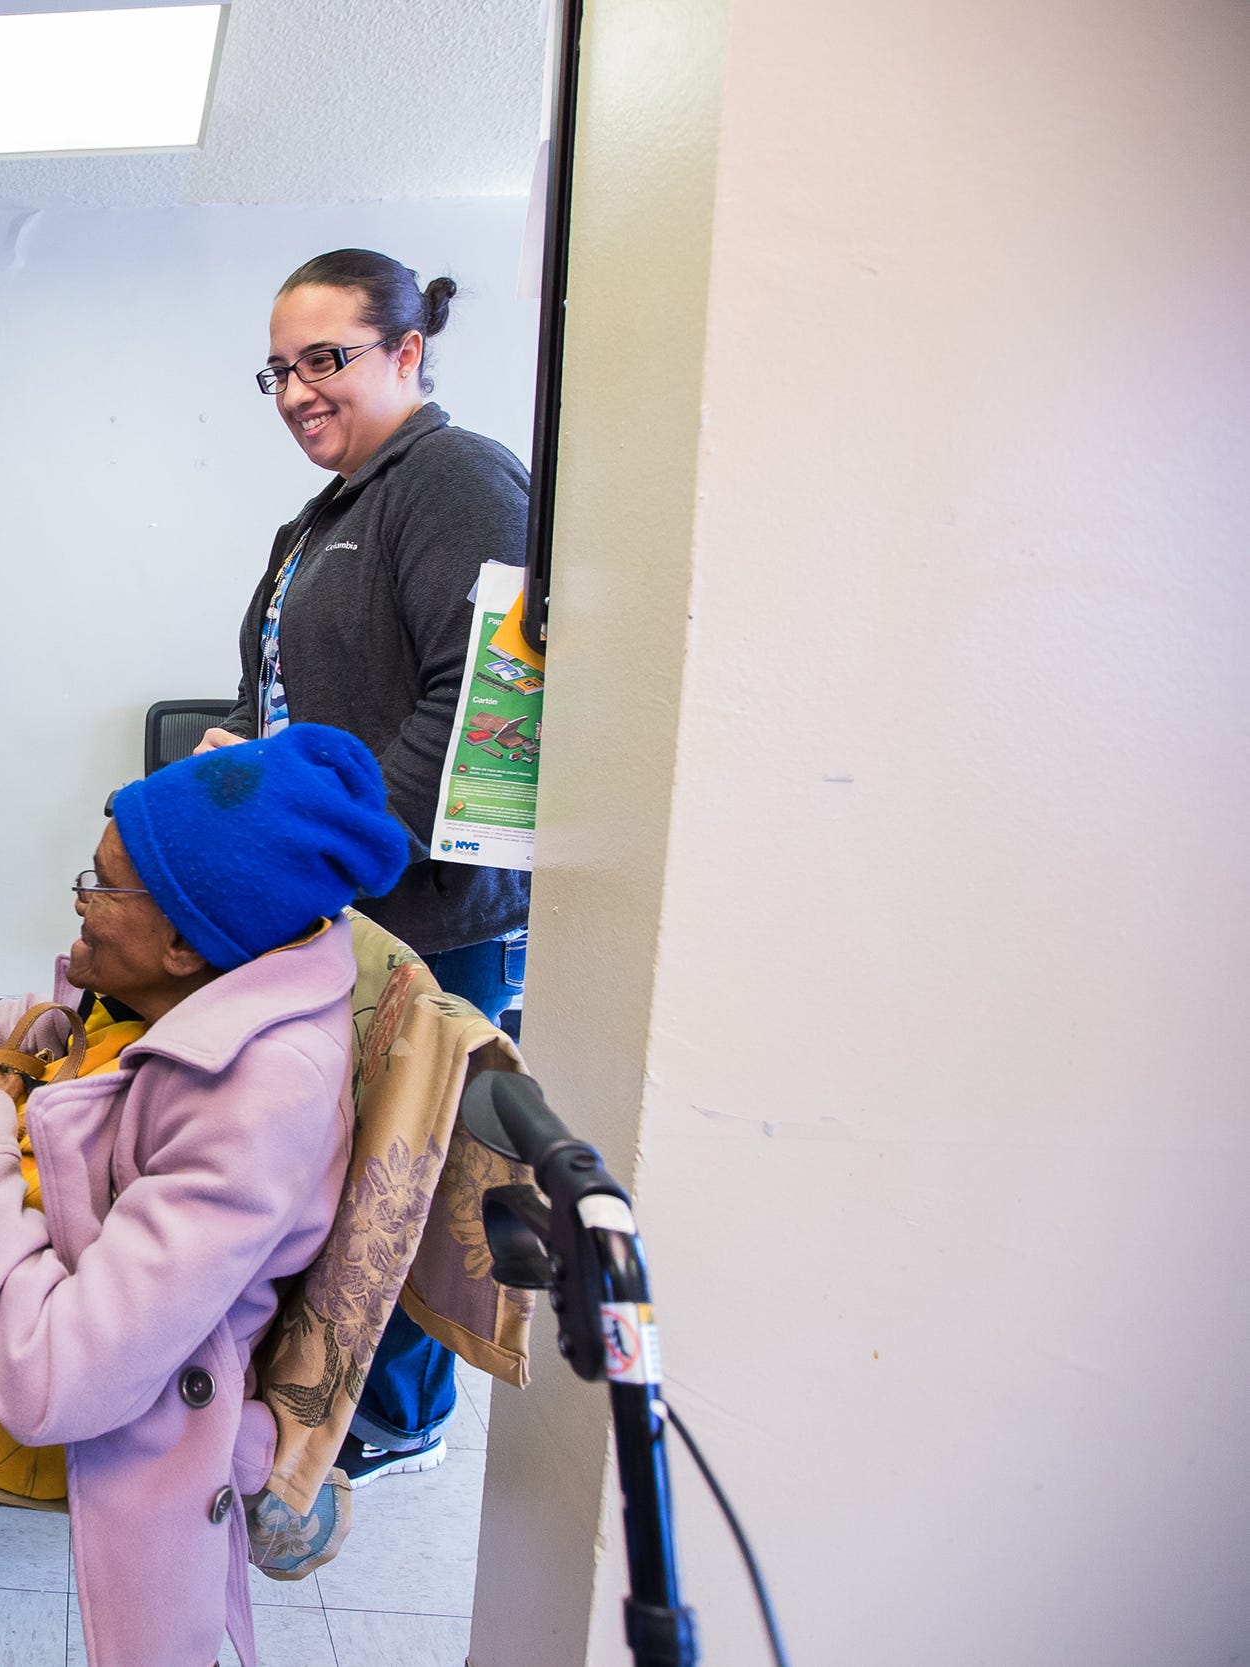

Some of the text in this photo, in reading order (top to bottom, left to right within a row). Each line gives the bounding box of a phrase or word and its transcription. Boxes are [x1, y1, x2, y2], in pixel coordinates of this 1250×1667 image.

[325, 540, 358, 551] Columbia
[472, 696, 498, 705] Cartón
[455, 840, 480, 851] NYC
